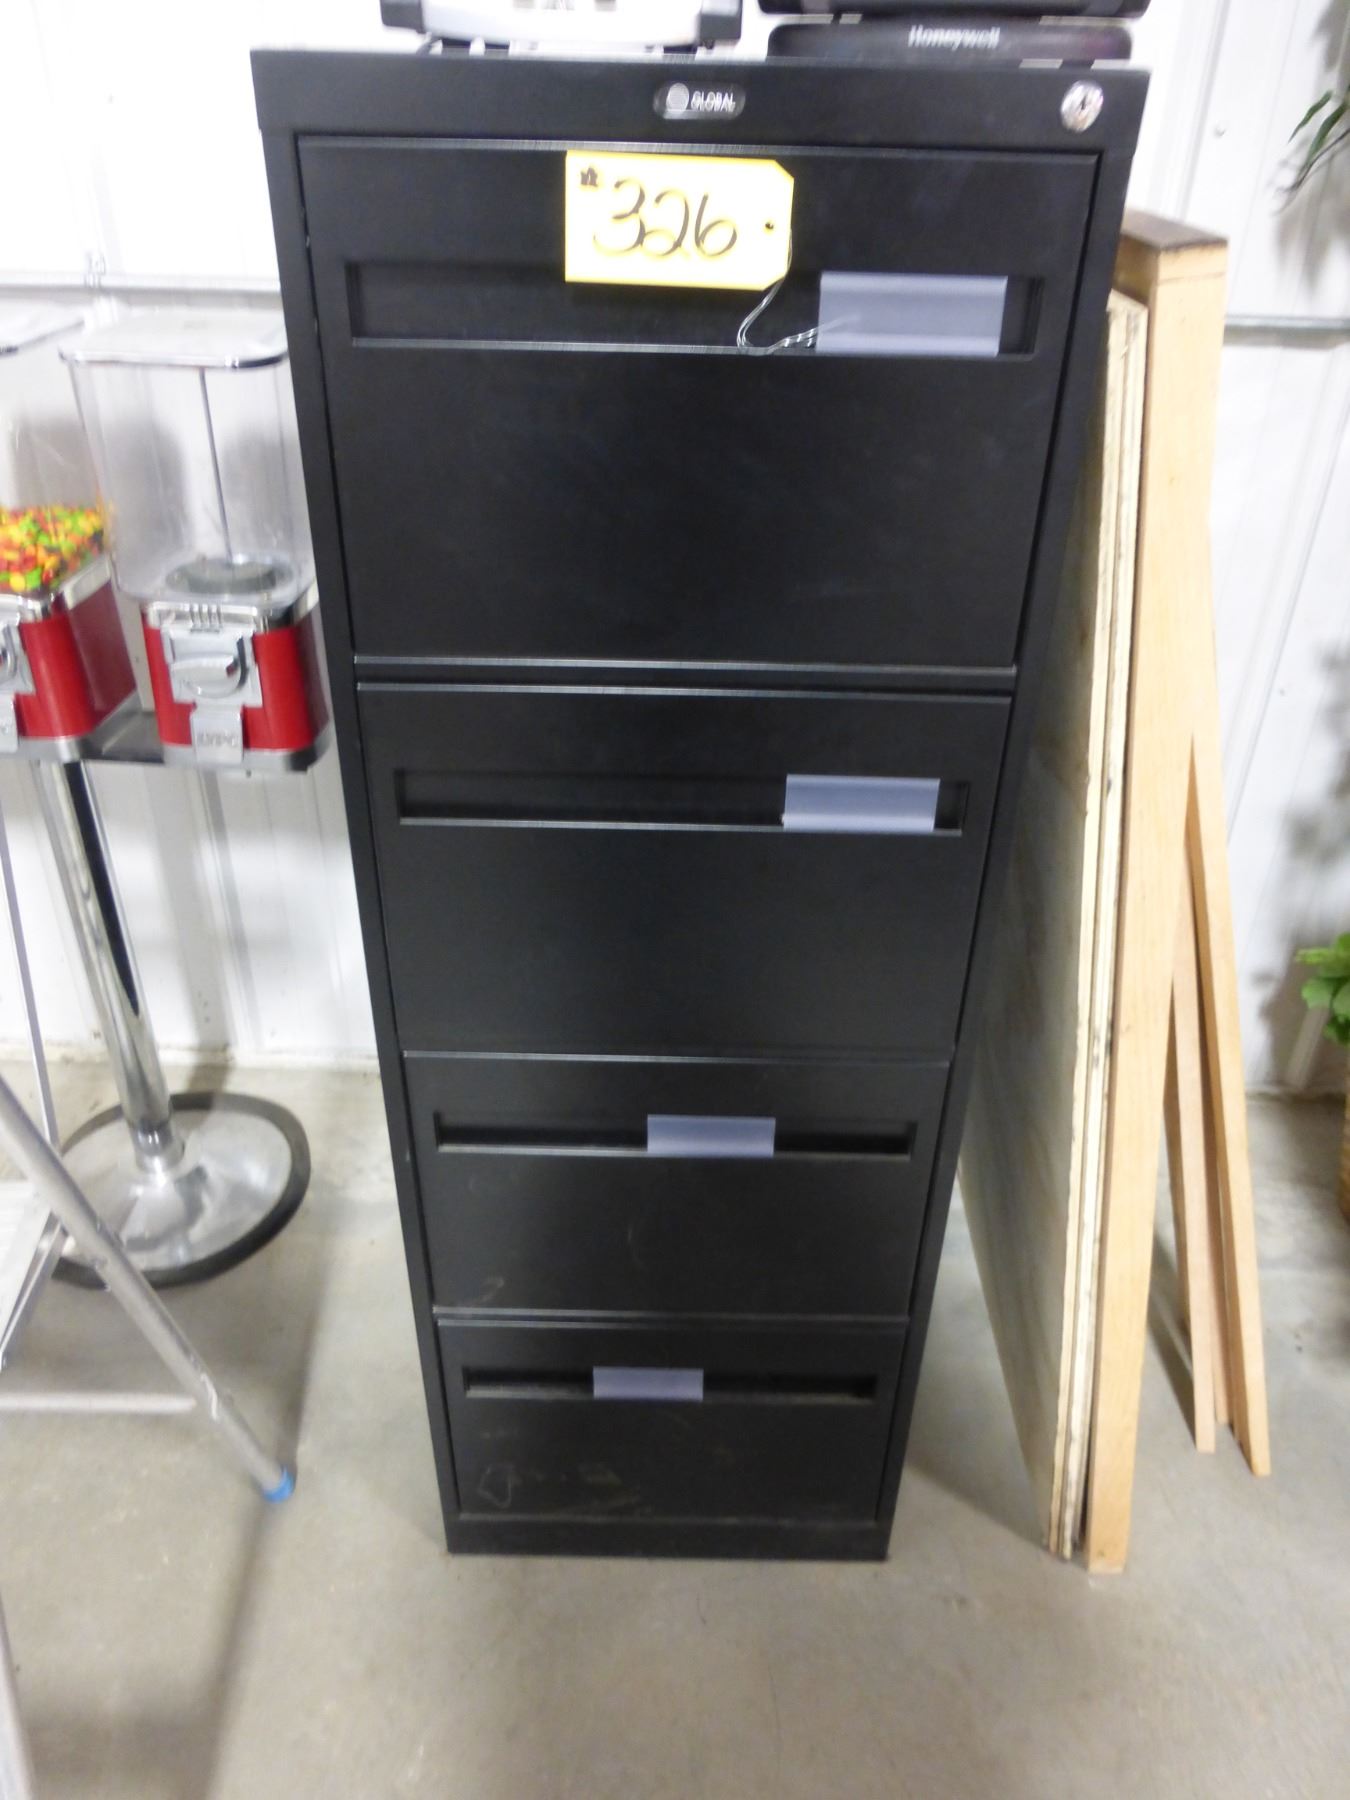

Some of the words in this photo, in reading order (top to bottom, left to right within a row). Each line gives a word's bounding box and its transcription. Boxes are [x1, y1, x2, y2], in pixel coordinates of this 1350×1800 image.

[908, 25, 1000, 51] Honeywell
[690, 90, 736, 112] GLOBAL
[593, 178, 738, 258] 326
